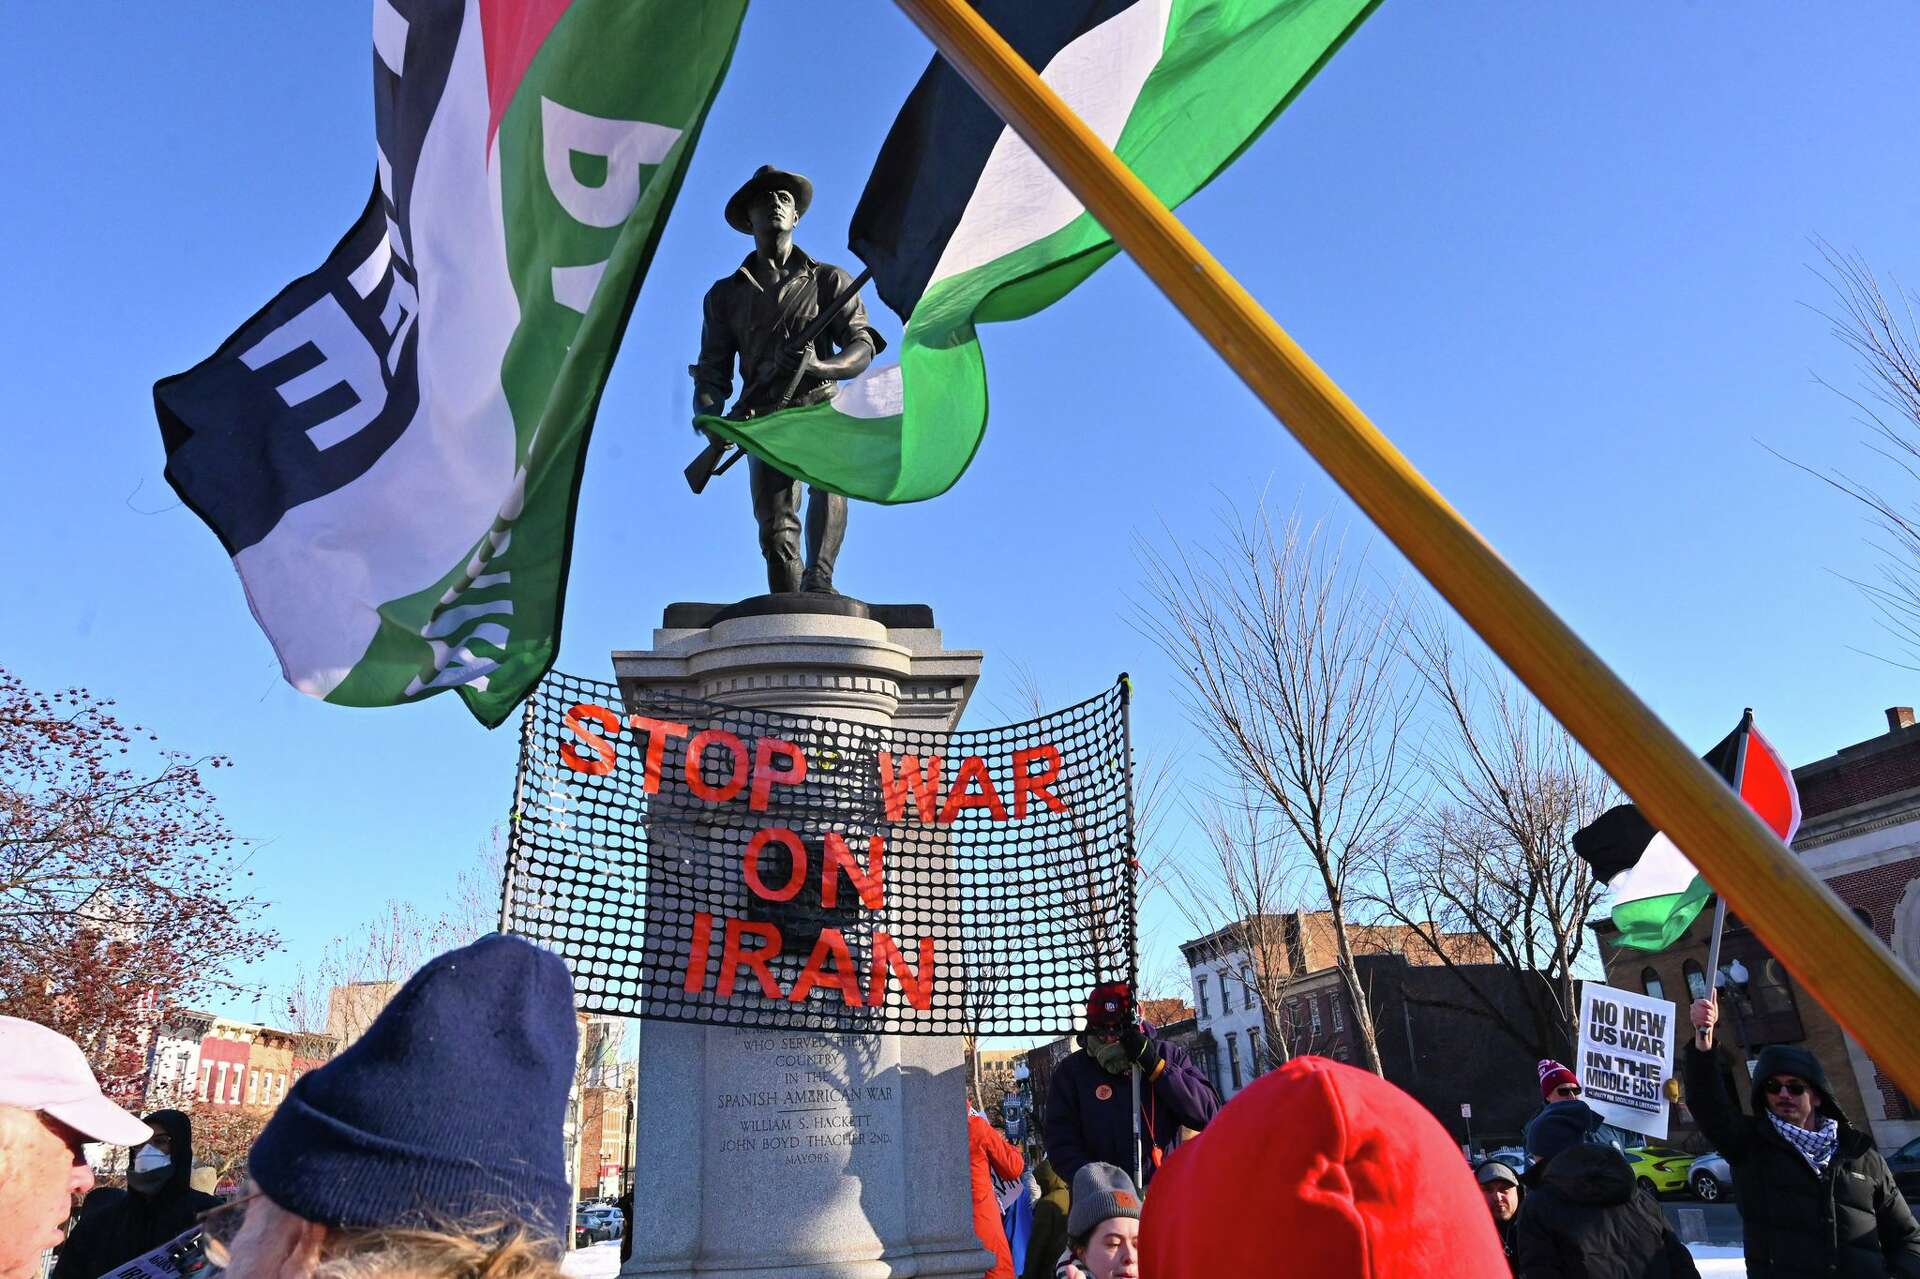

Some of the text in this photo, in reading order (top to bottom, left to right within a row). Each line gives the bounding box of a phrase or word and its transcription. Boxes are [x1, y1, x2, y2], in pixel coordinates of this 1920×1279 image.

[560, 703, 1068, 823] STOP WAR
[743, 827, 885, 910] ON
[684, 911, 934, 1011] IRAN
[1592, 998, 1667, 1039] NO NEW
[743, 1039, 774, 1050] WHO
[782, 1037, 827, 1049] SERVED
[1590, 1023, 1666, 1059] US WAR
[775, 1054, 839, 1067] COUNTRY
[1586, 1051, 1662, 1082] IN THE
[785, 1071, 830, 1084] IN THE
[1586, 1067, 1661, 1101] MIDDLE EAST
[718, 1086, 893, 1109] SPANISH AMERICAN WAR
[740, 1114, 873, 1133] WILLIAM S. HACKETT
[720, 1137, 756, 1153] JOHN
[762, 1136, 800, 1150] BOYD
[806, 1133, 866, 1147] THACHER
[785, 1152, 829, 1166] MAYORS
